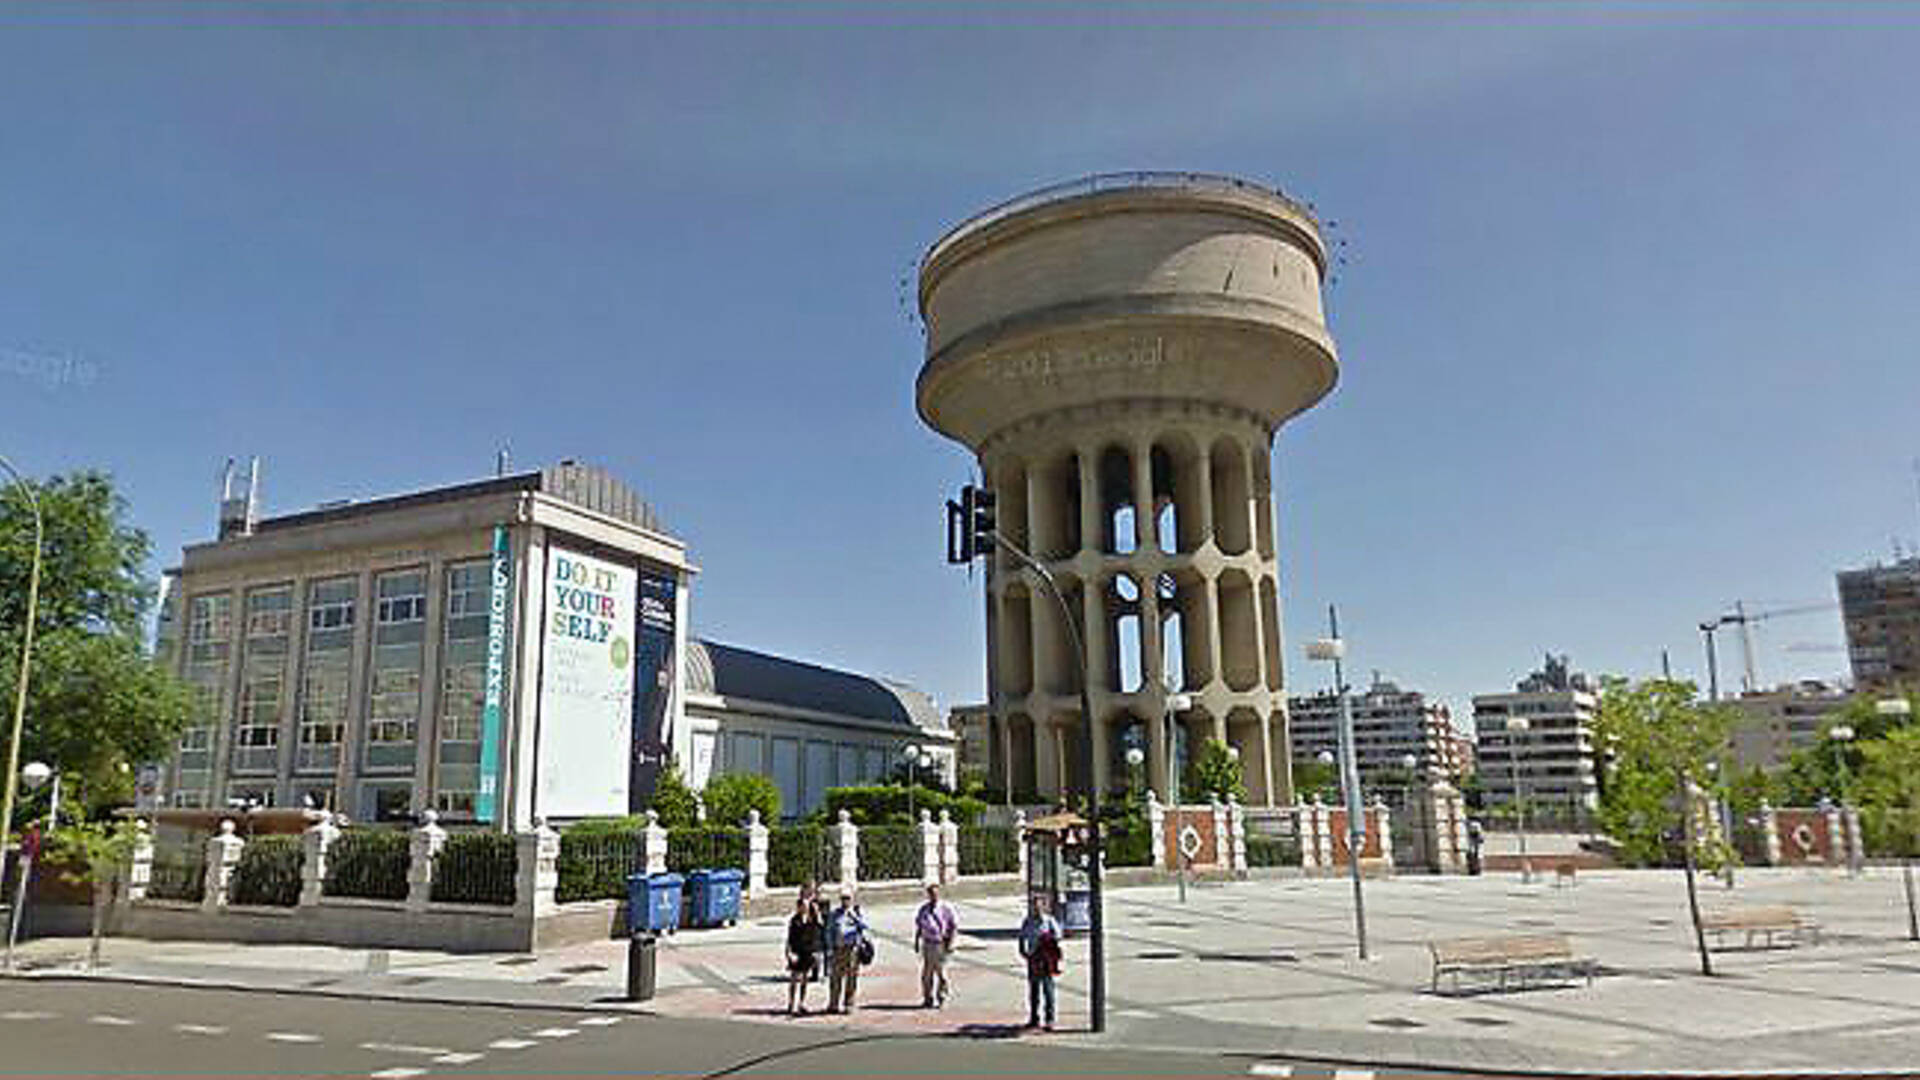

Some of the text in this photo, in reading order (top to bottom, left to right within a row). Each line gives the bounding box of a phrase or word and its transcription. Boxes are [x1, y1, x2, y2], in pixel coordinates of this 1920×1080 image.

[556, 556, 618, 593] DO IT
[555, 584, 615, 619] YOUR
[552, 612, 613, 643] SELF
